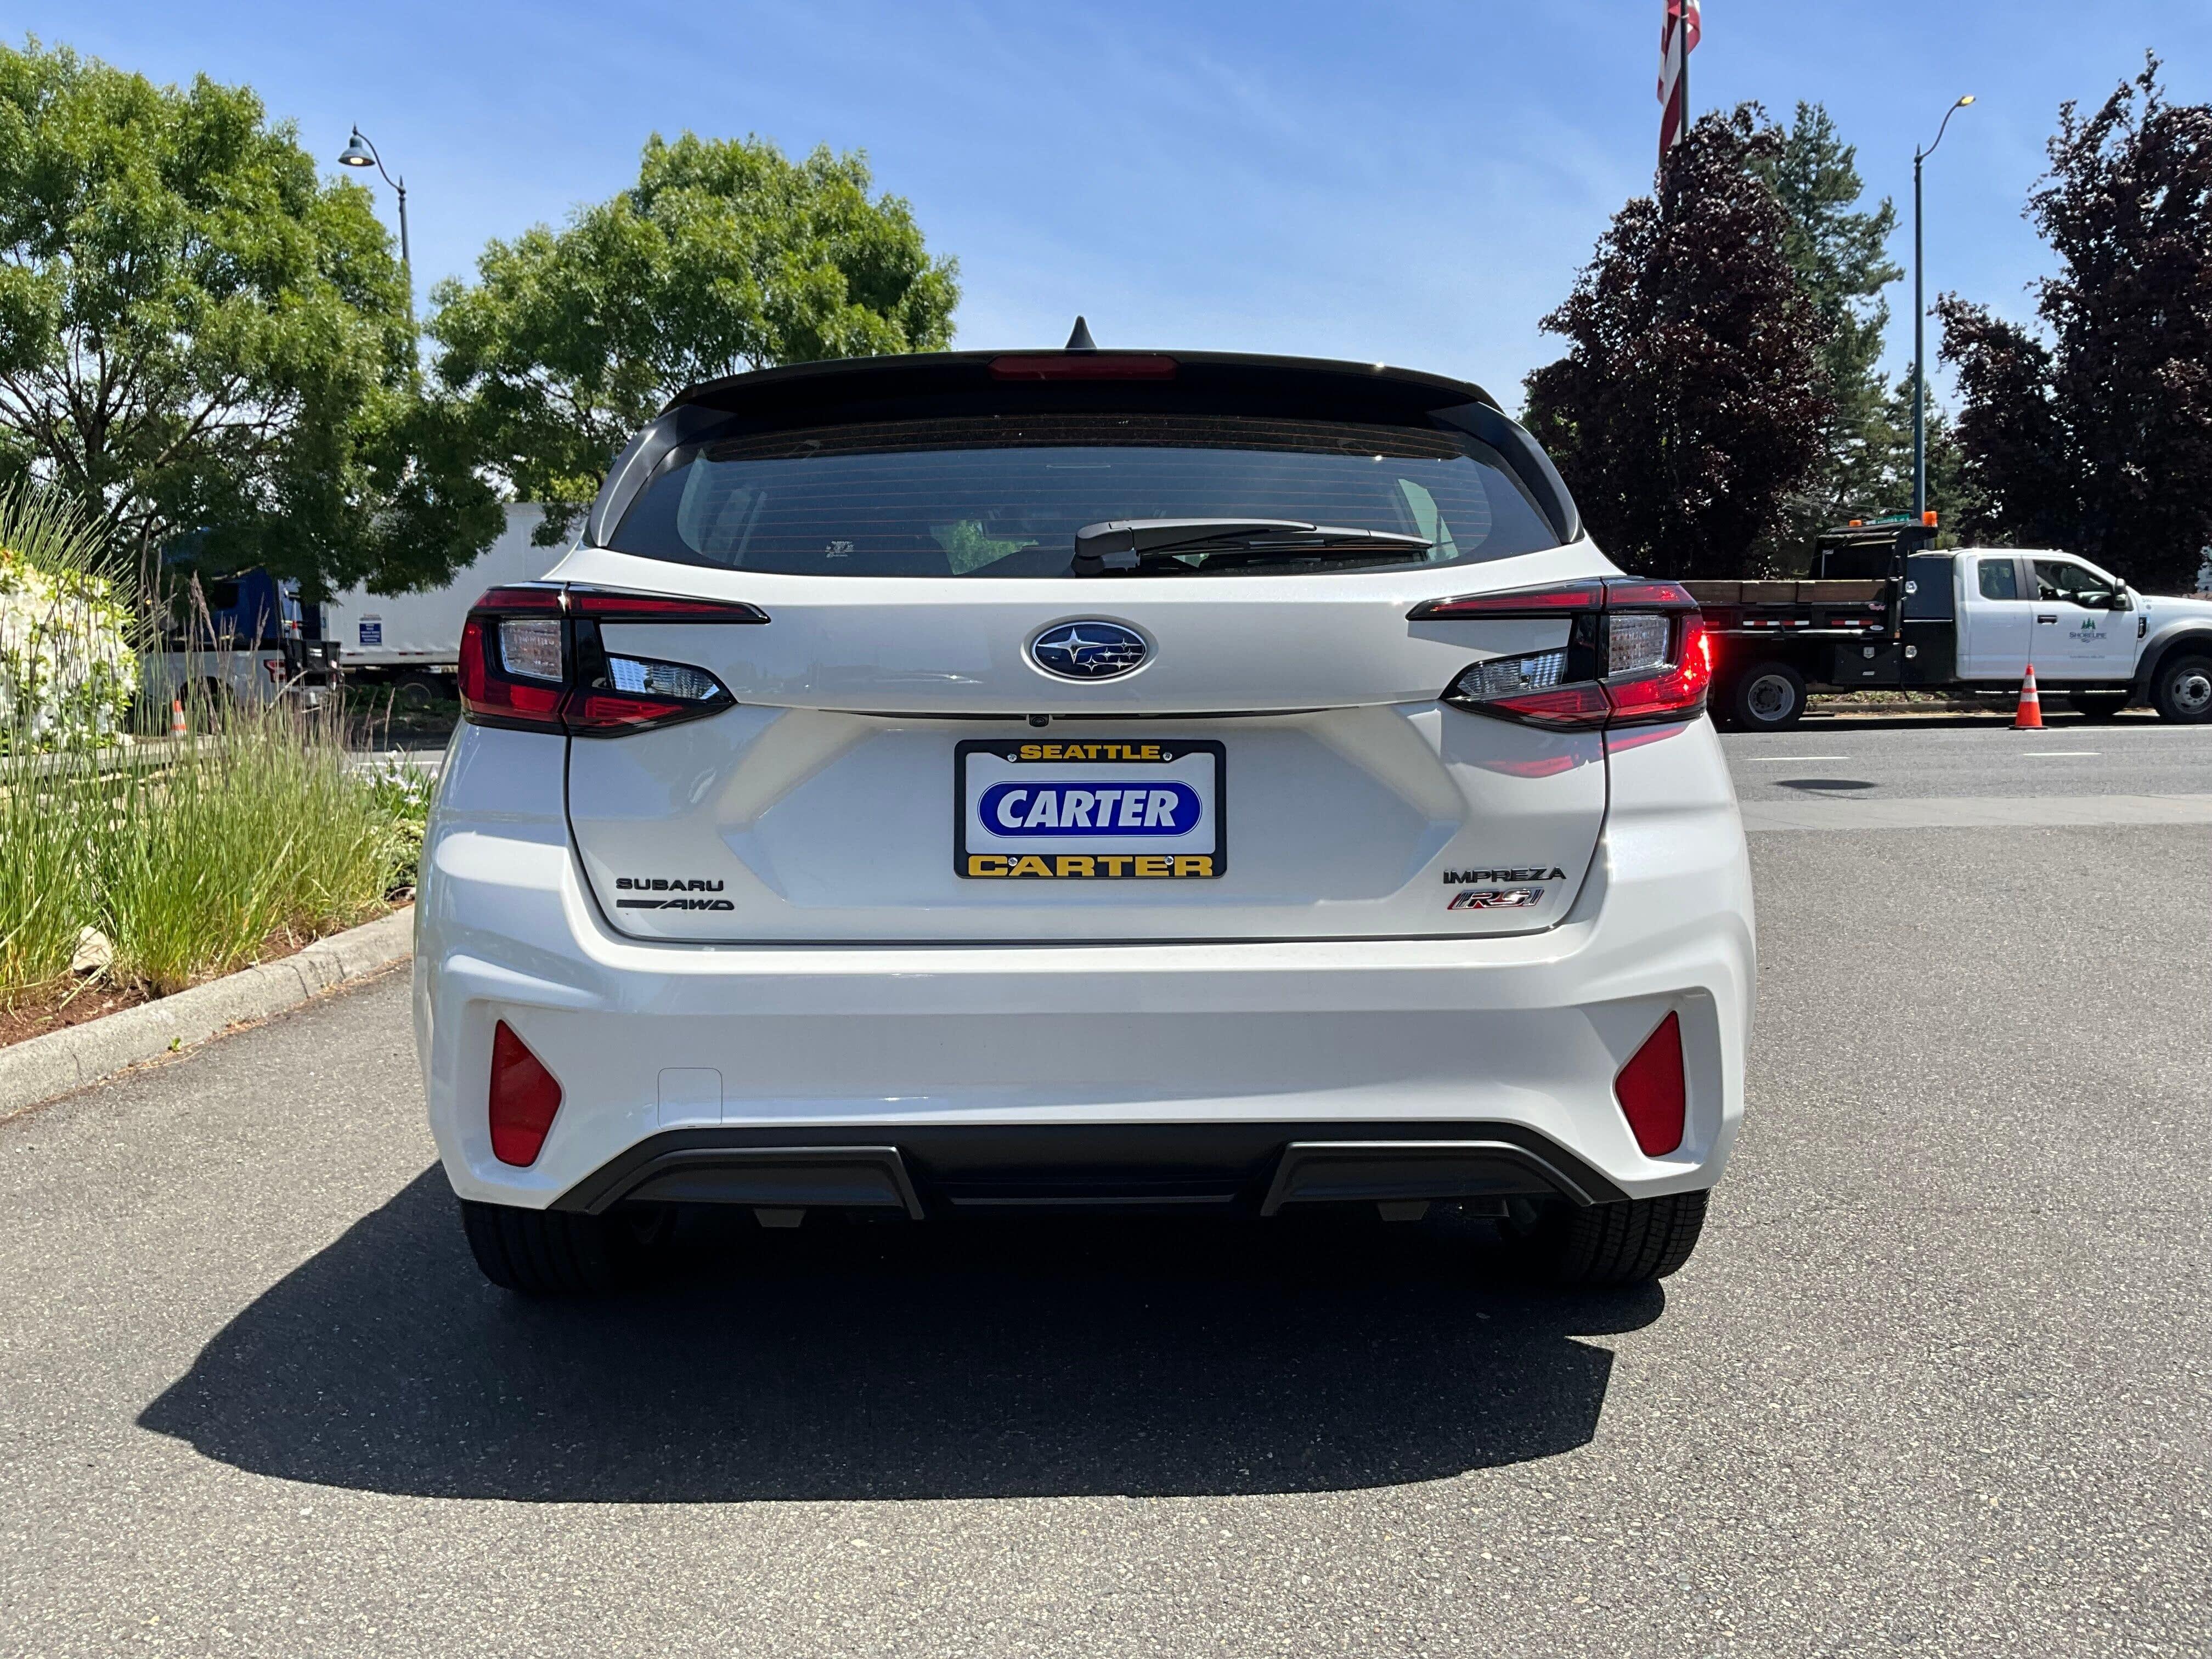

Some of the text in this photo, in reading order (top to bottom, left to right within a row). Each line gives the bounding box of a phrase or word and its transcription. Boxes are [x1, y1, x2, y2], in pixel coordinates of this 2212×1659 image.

[1020, 744, 1160, 759] SEATTLE
[997, 789, 1179, 828] CARTER
[968, 855, 1213, 877] CARTER
[1443, 866, 1567, 884] IMPREZA
[616, 878, 724, 891] SUBARU
[659, 899, 735, 911] AWD
[1463, 888, 1532, 909] RS
